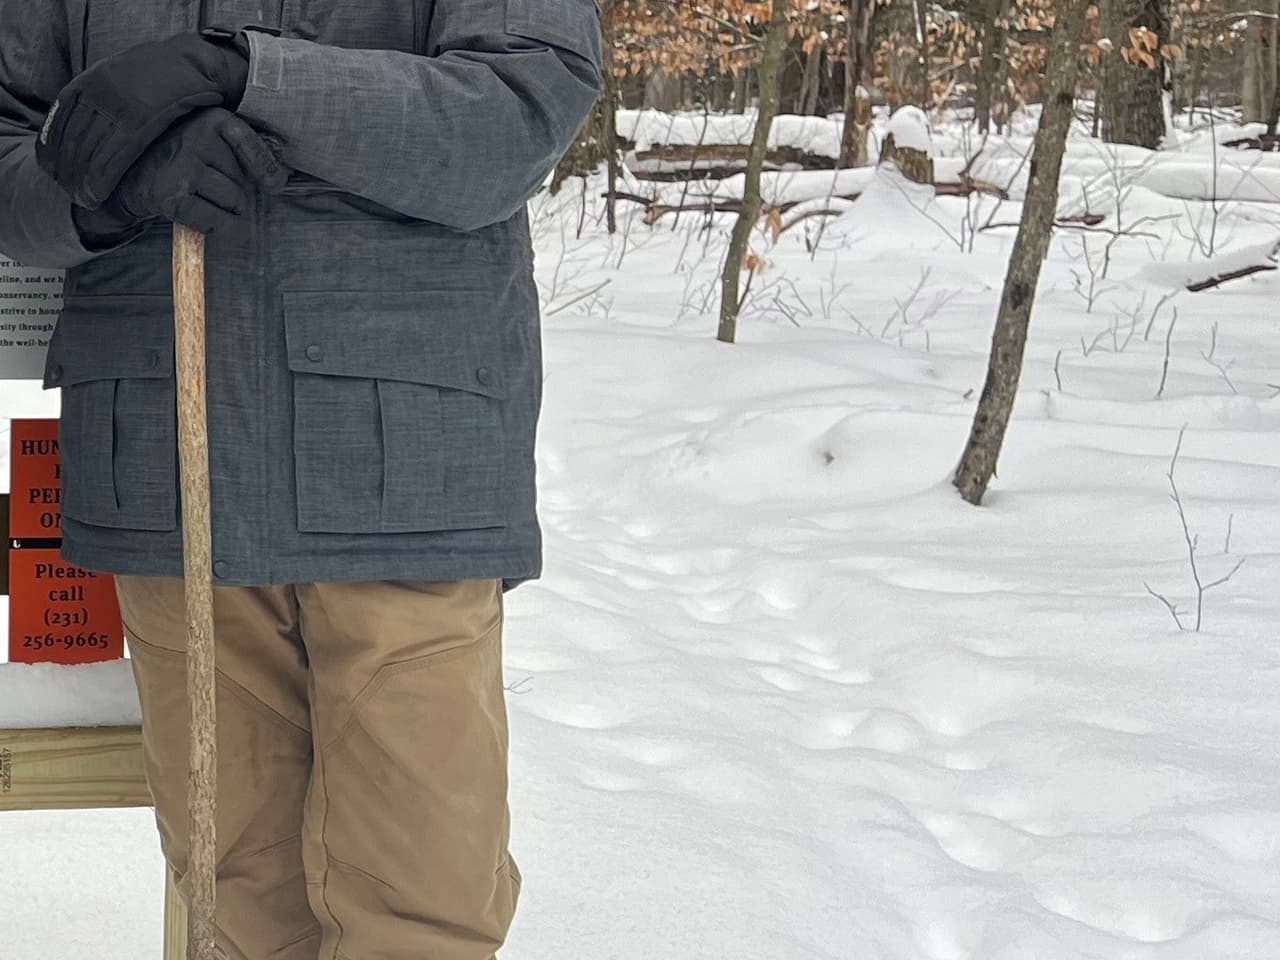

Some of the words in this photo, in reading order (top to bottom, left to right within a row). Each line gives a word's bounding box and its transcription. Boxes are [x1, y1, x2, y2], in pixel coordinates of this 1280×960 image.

[25, 275, 40, 283] and
[19, 323, 54, 332] through
[49, 585, 84, 601] call
[44, 607, 89, 627] (231)
[23, 632, 109, 650] 256-9665
